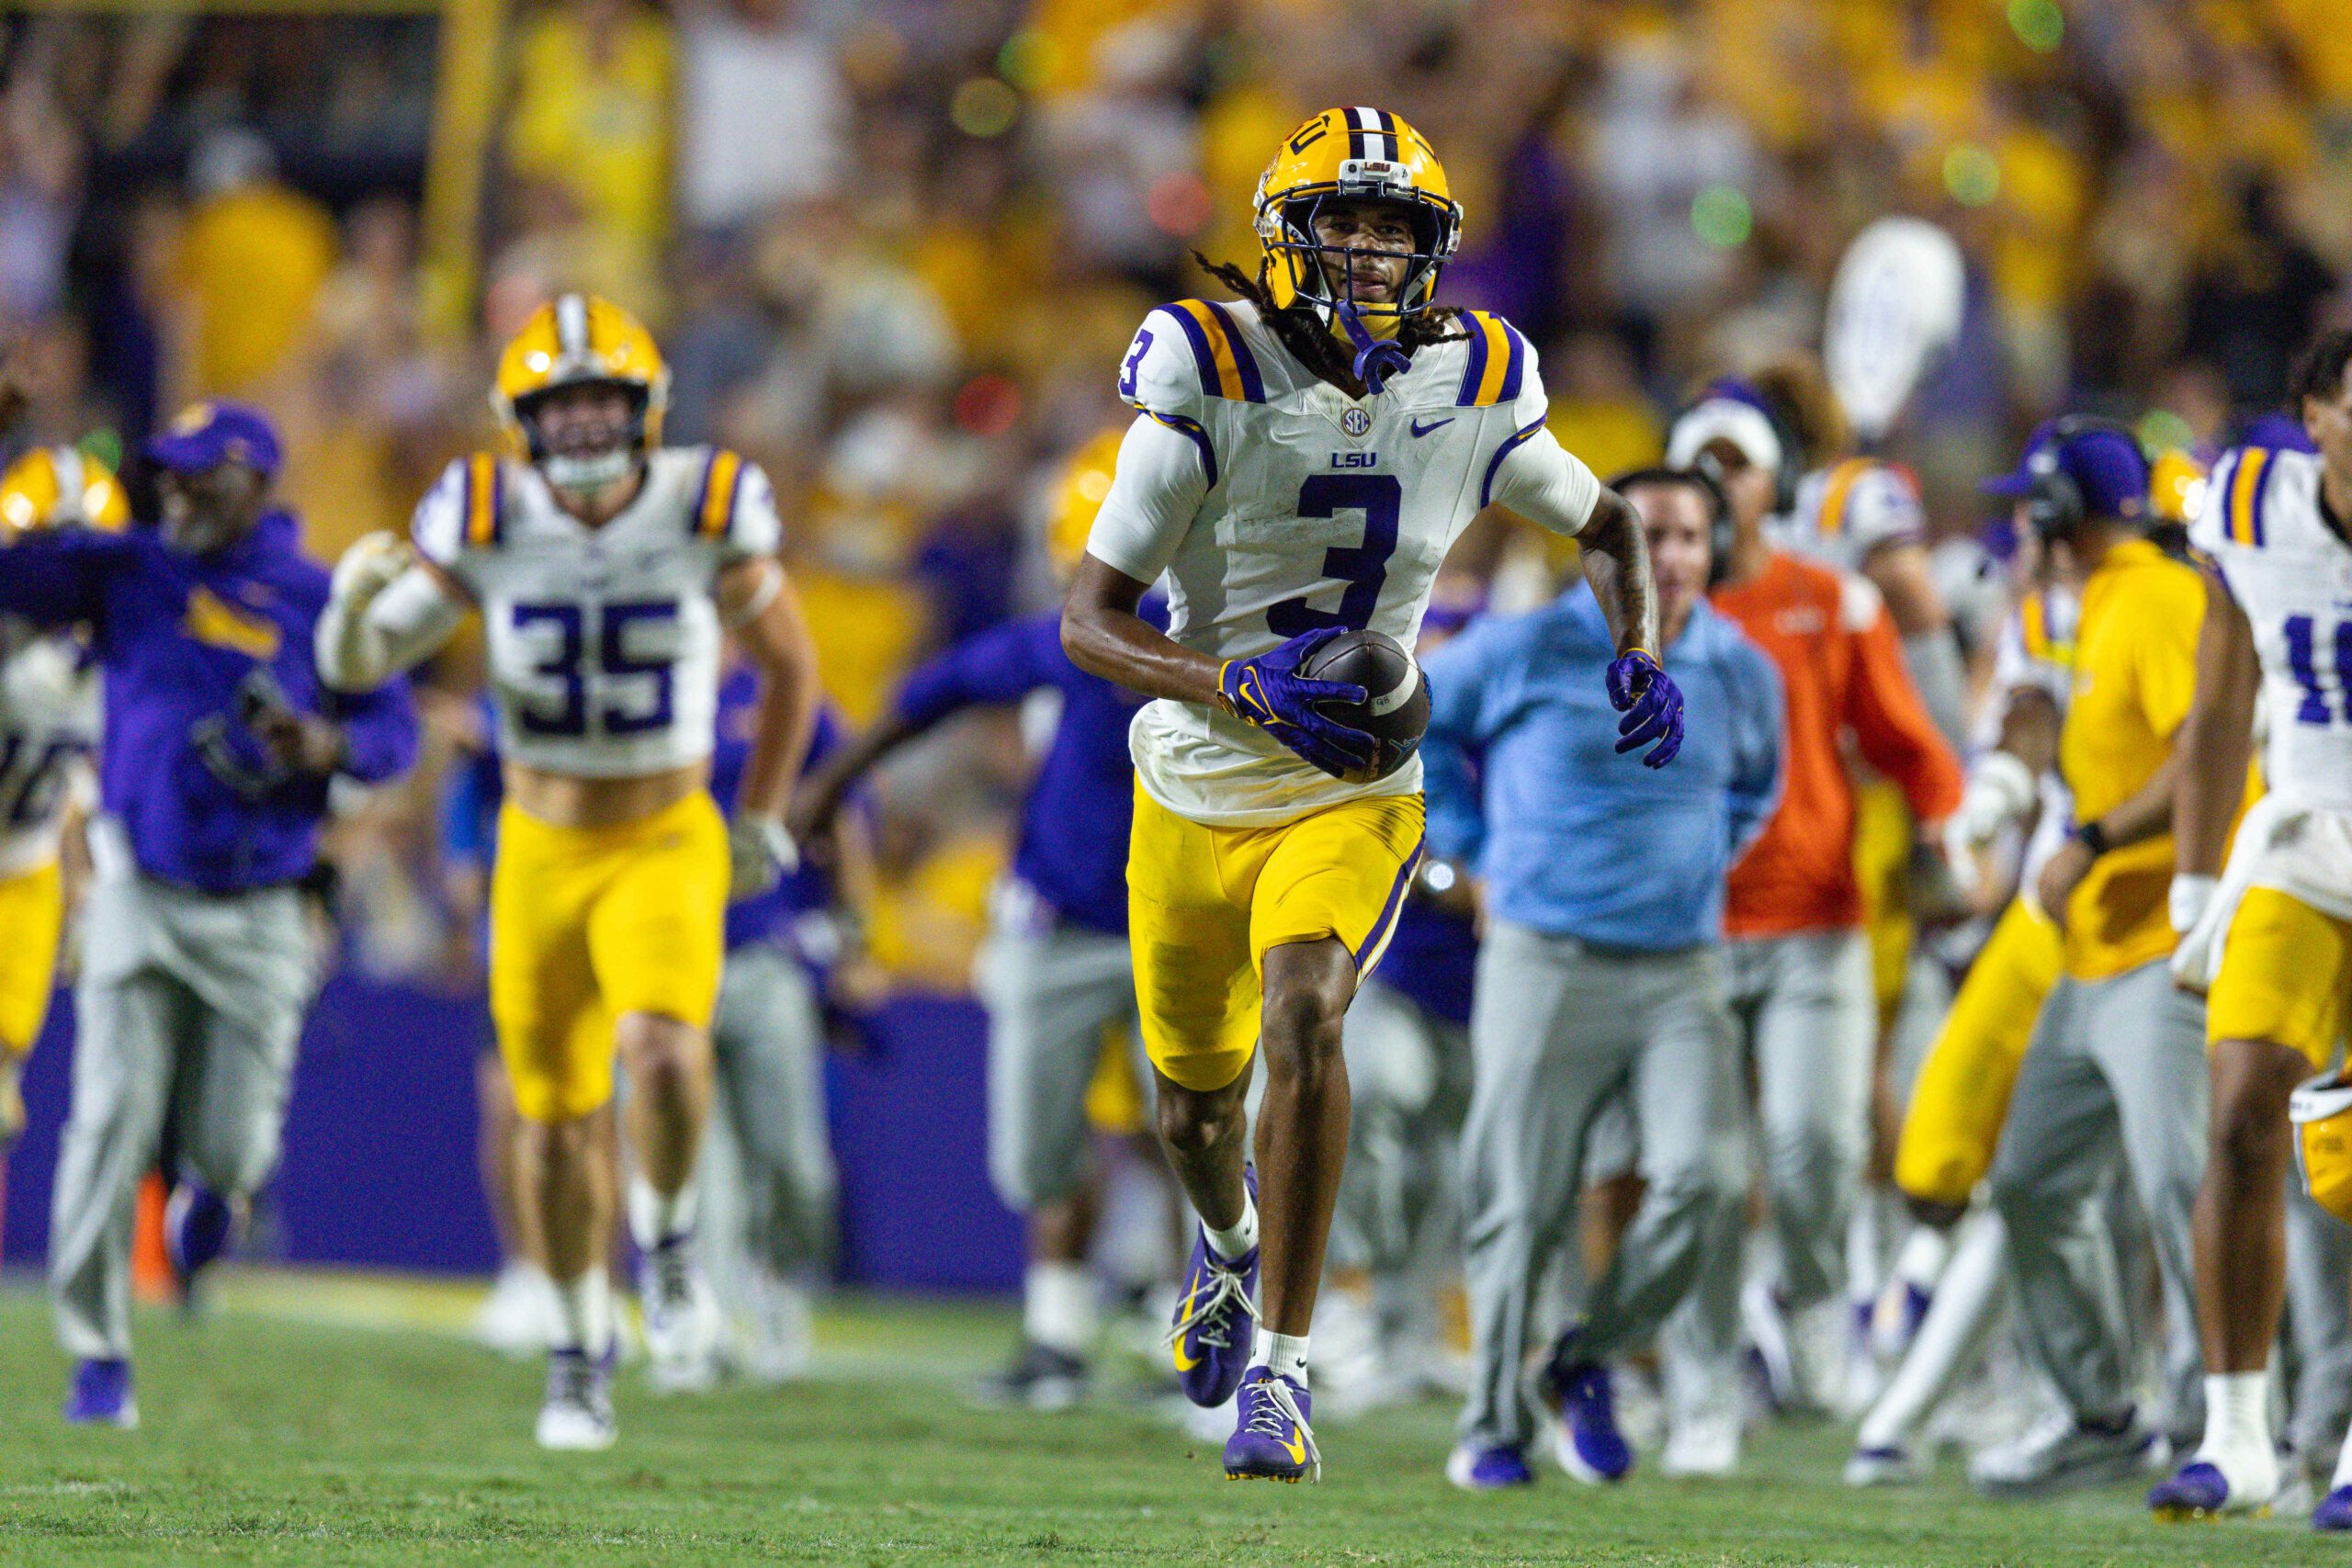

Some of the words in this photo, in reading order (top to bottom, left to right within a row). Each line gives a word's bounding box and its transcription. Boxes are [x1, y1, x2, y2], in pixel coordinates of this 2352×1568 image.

[1363, 161, 1391, 173] LSU
[1119, 328, 1154, 397] 3
[1344, 409, 1370, 434] SEC
[1331, 452, 1377, 468] LSU
[1265, 474, 1403, 639] 3
[512, 598, 680, 738] 35
